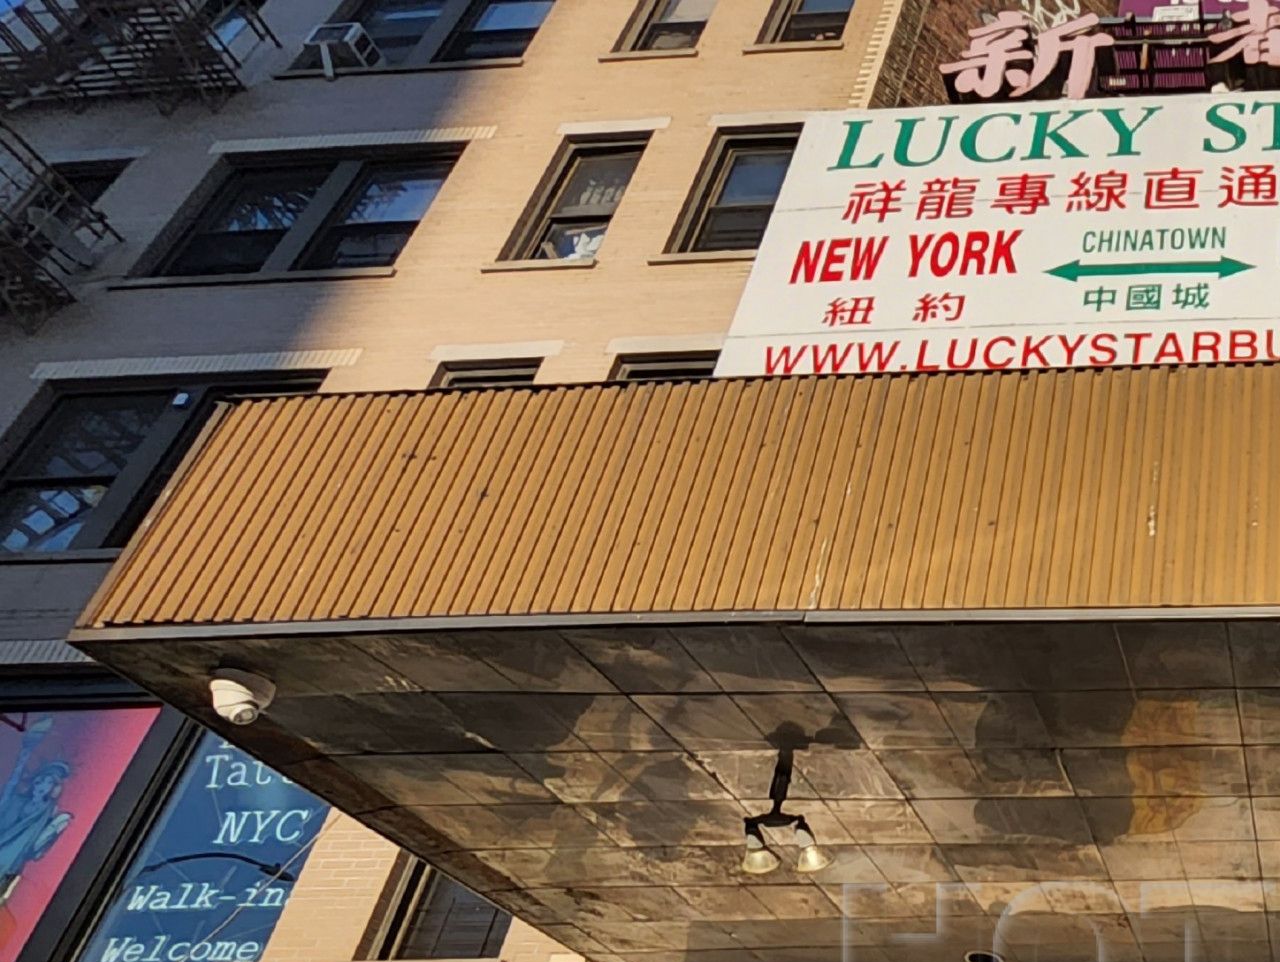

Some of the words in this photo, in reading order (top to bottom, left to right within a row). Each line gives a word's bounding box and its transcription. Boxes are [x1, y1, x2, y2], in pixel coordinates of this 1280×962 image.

[828, 106, 1164, 169] LUCKY
[790, 236, 889, 284] NEW
[909, 229, 1024, 277] YORK
[1083, 226, 1227, 253] CHINATOWN
[1084, 283, 1209, 311] 中國城
[206, 754, 294, 788] Tat
[213, 810, 308, 844] NYC
